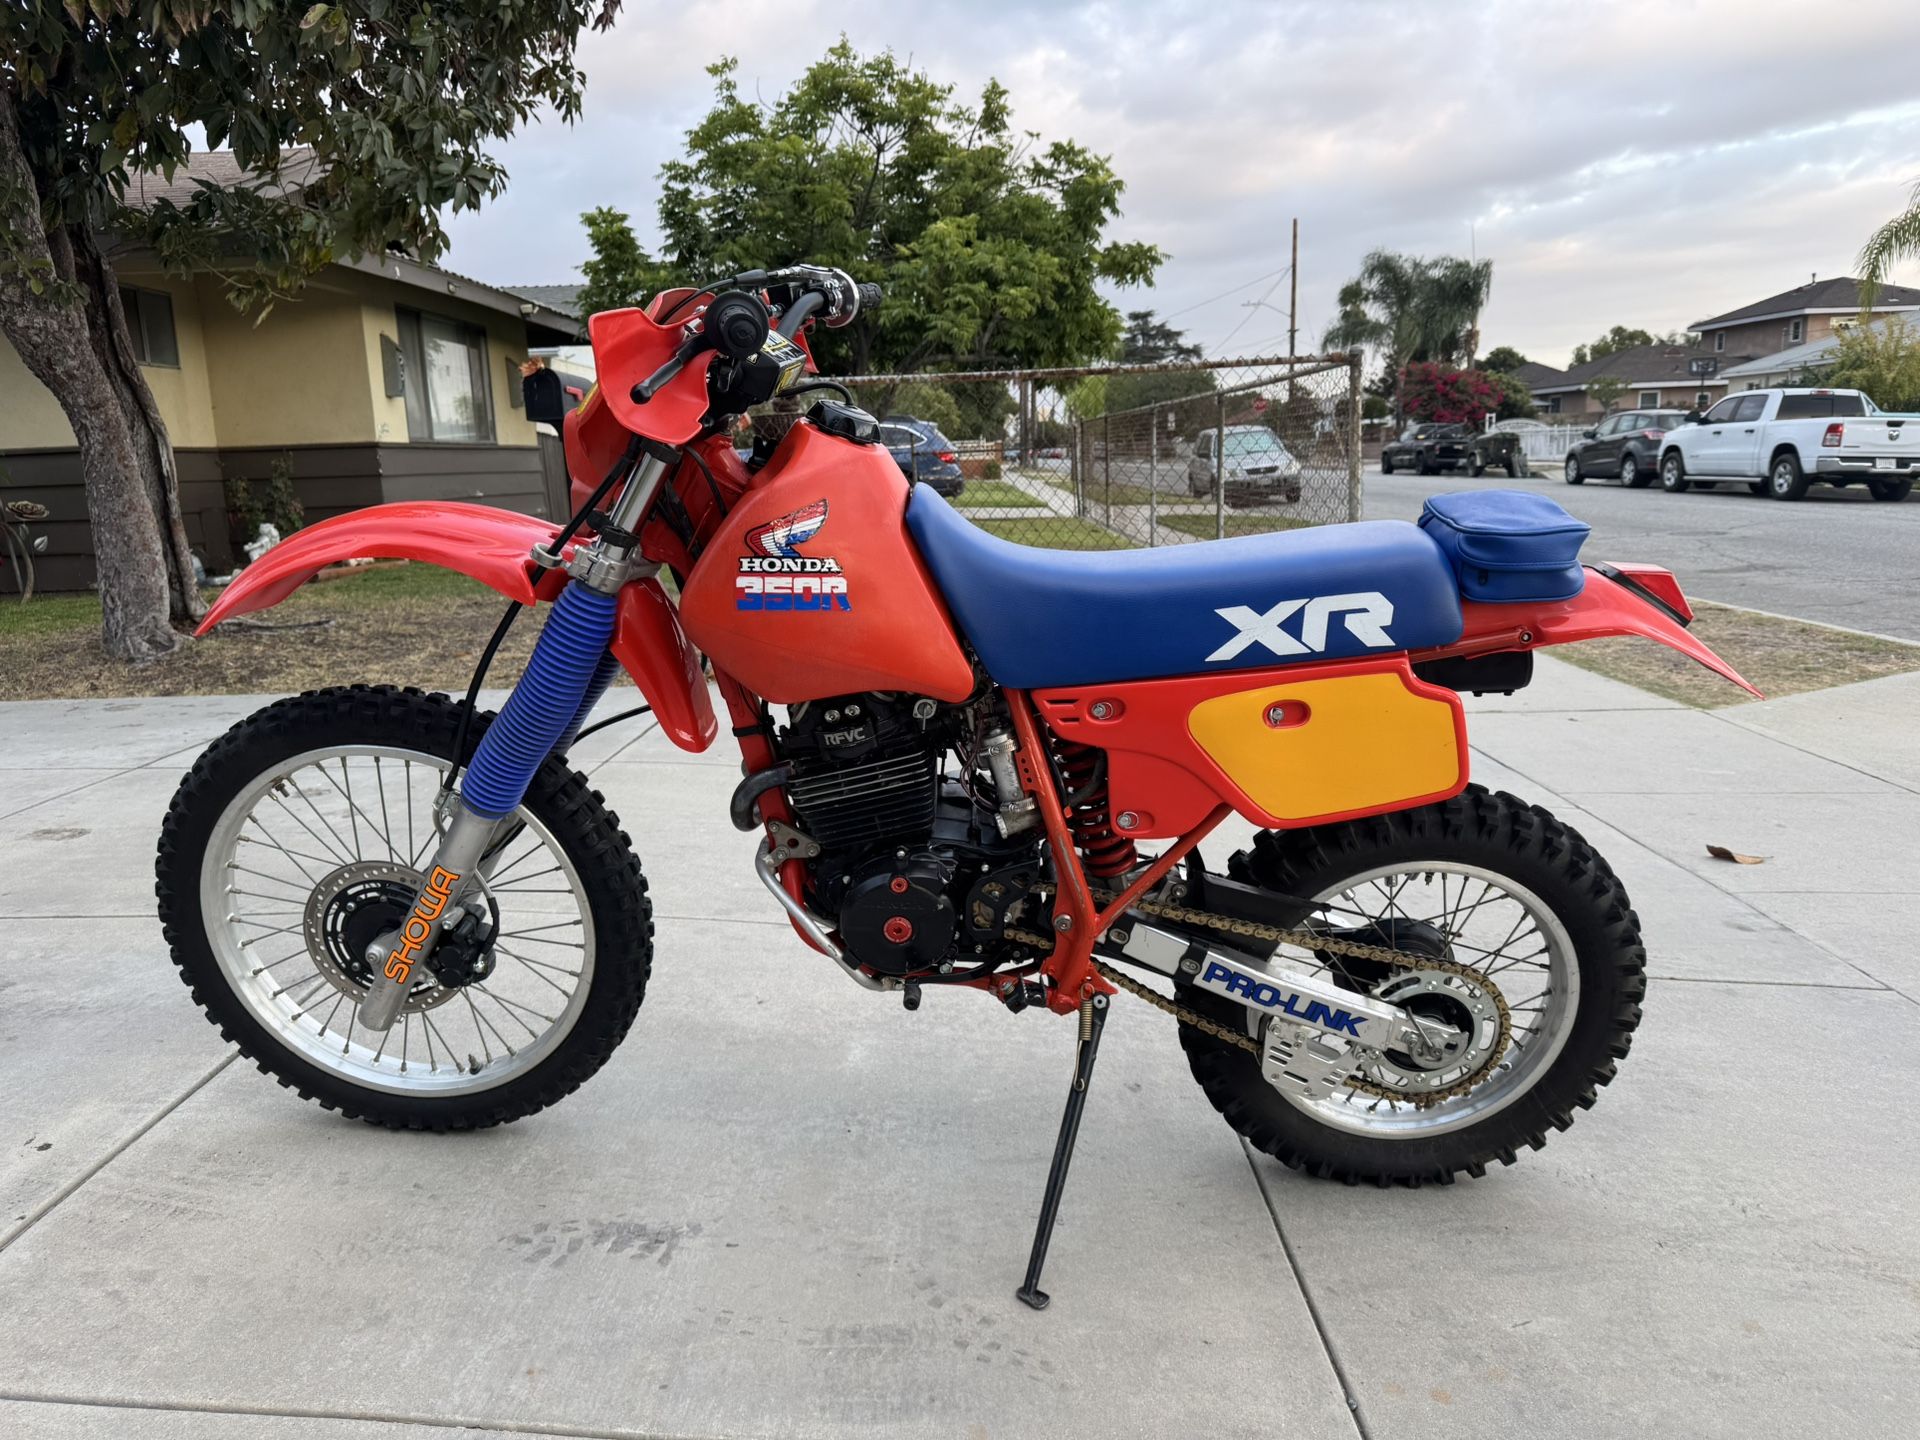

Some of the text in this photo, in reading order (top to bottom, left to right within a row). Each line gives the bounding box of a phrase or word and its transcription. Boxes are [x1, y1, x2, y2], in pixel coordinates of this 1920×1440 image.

[740, 558, 841, 573] HONDA
[1204, 592, 1396, 662] XR
[823, 727, 866, 746] RFVC
[384, 865, 460, 984] SHOWA
[1202, 962, 1370, 1038] PRO-LINK
